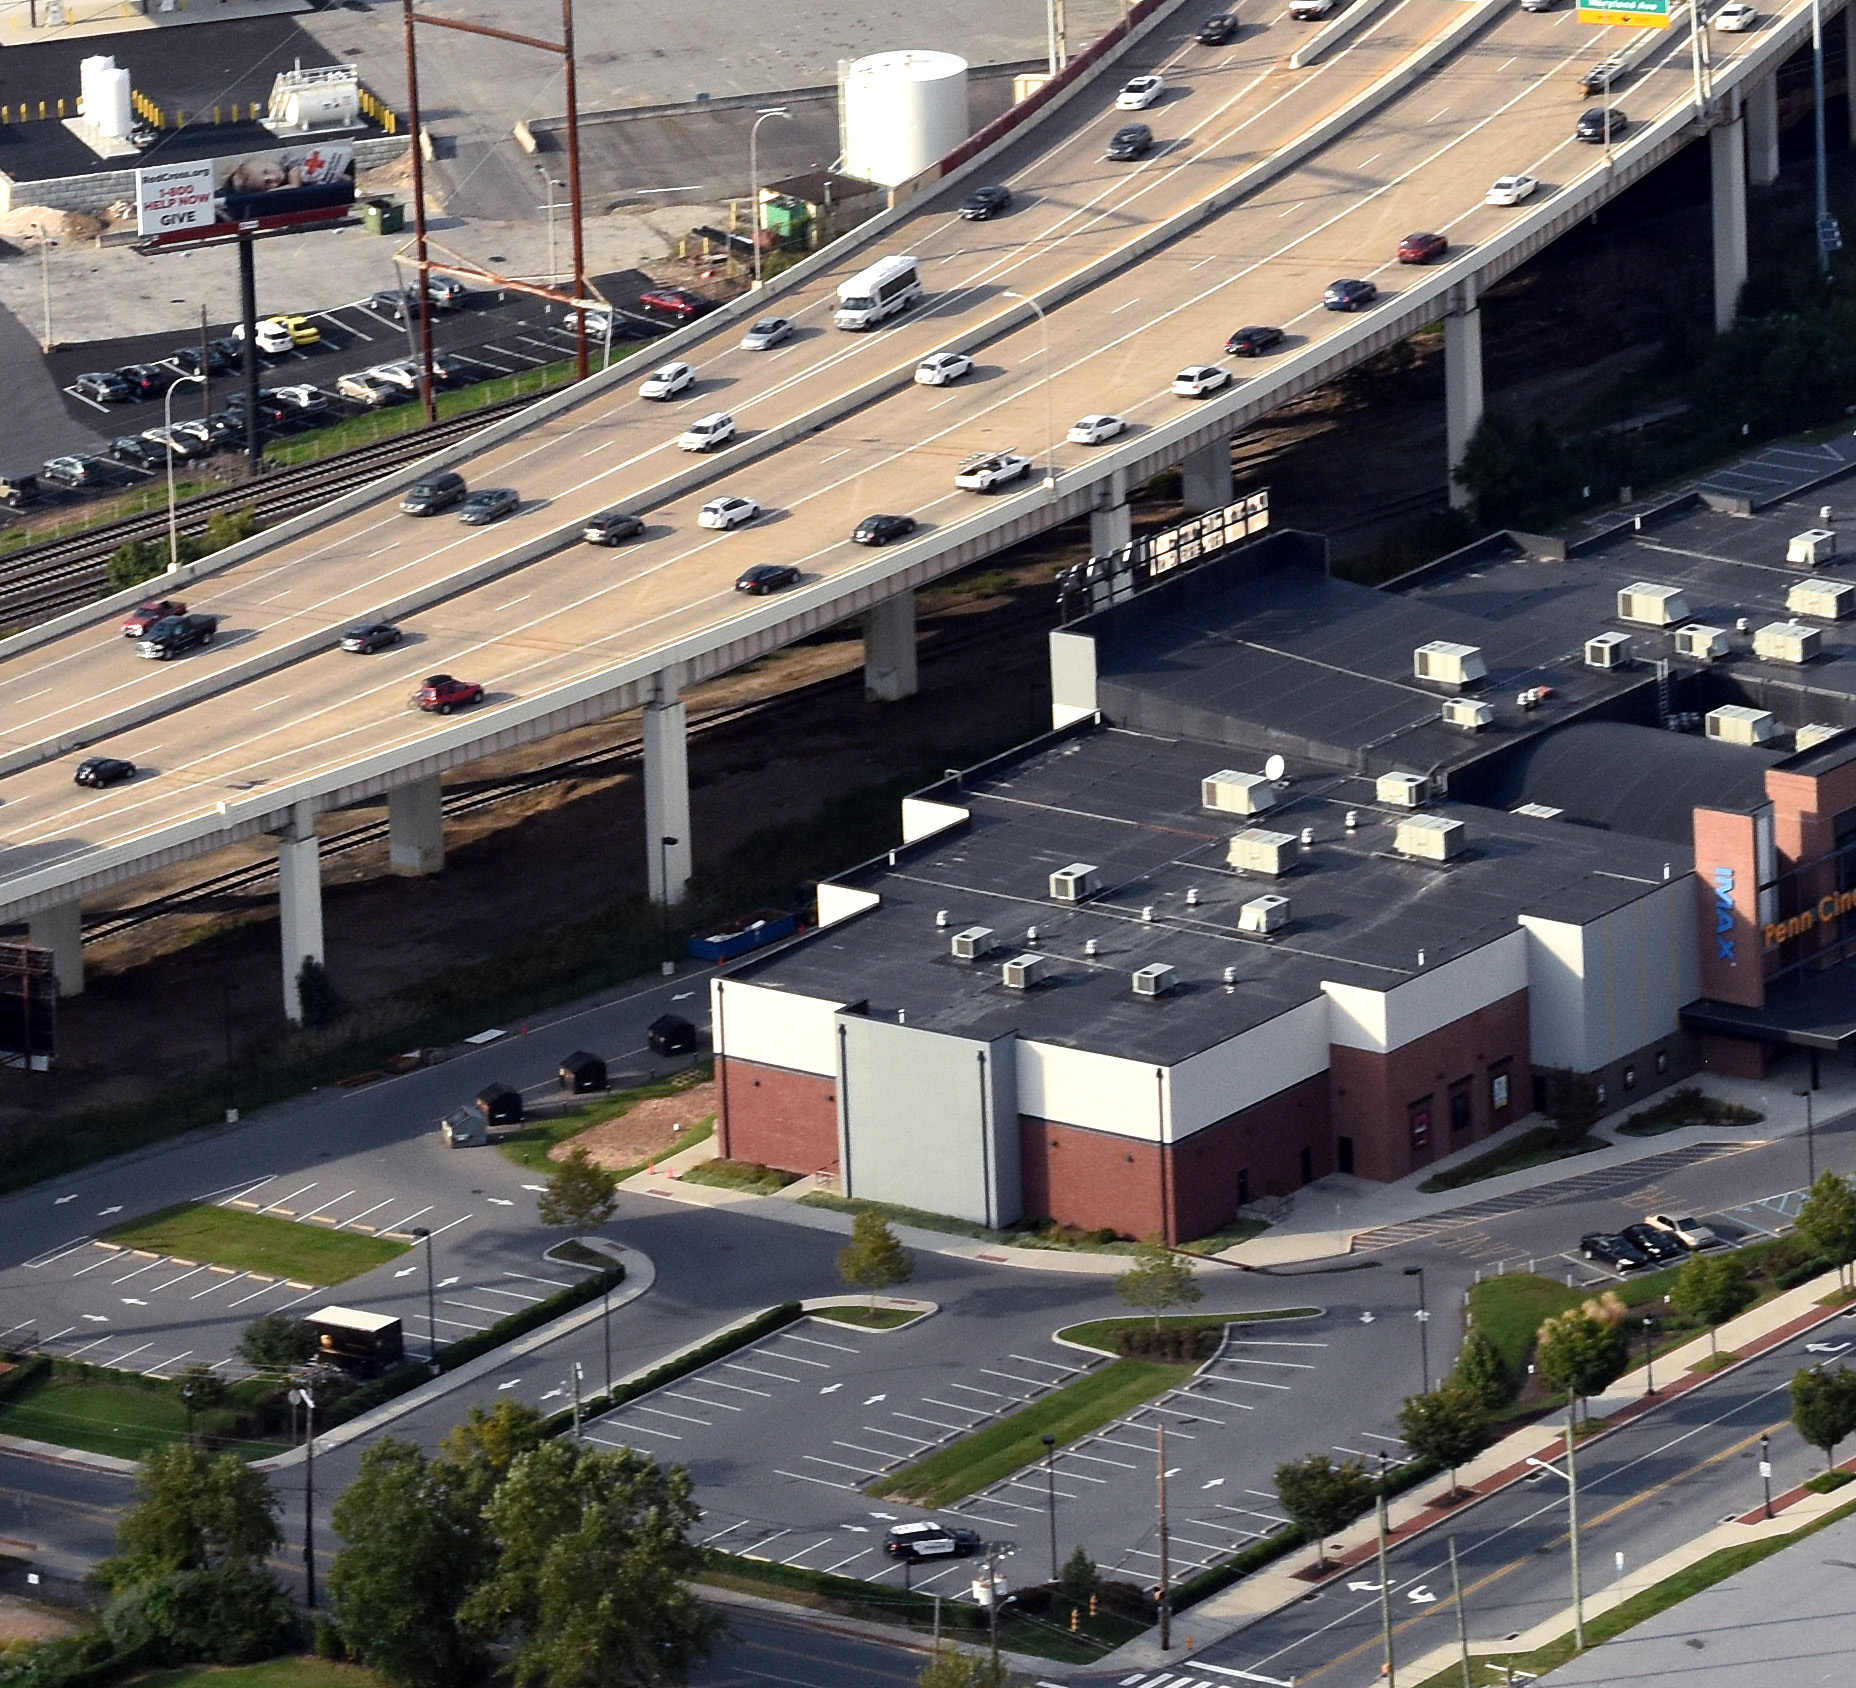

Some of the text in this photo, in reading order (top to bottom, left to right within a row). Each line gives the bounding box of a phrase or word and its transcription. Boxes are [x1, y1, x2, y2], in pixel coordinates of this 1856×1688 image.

[142, 168, 210, 184] RedCross.org
[159, 184, 193, 199] 1-800
[144, 194, 210, 211] HELP NOW
[160, 211, 196, 226] GIVE
[1714, 866, 1736, 960] IMAX
[1764, 910, 1813, 947] Penn
